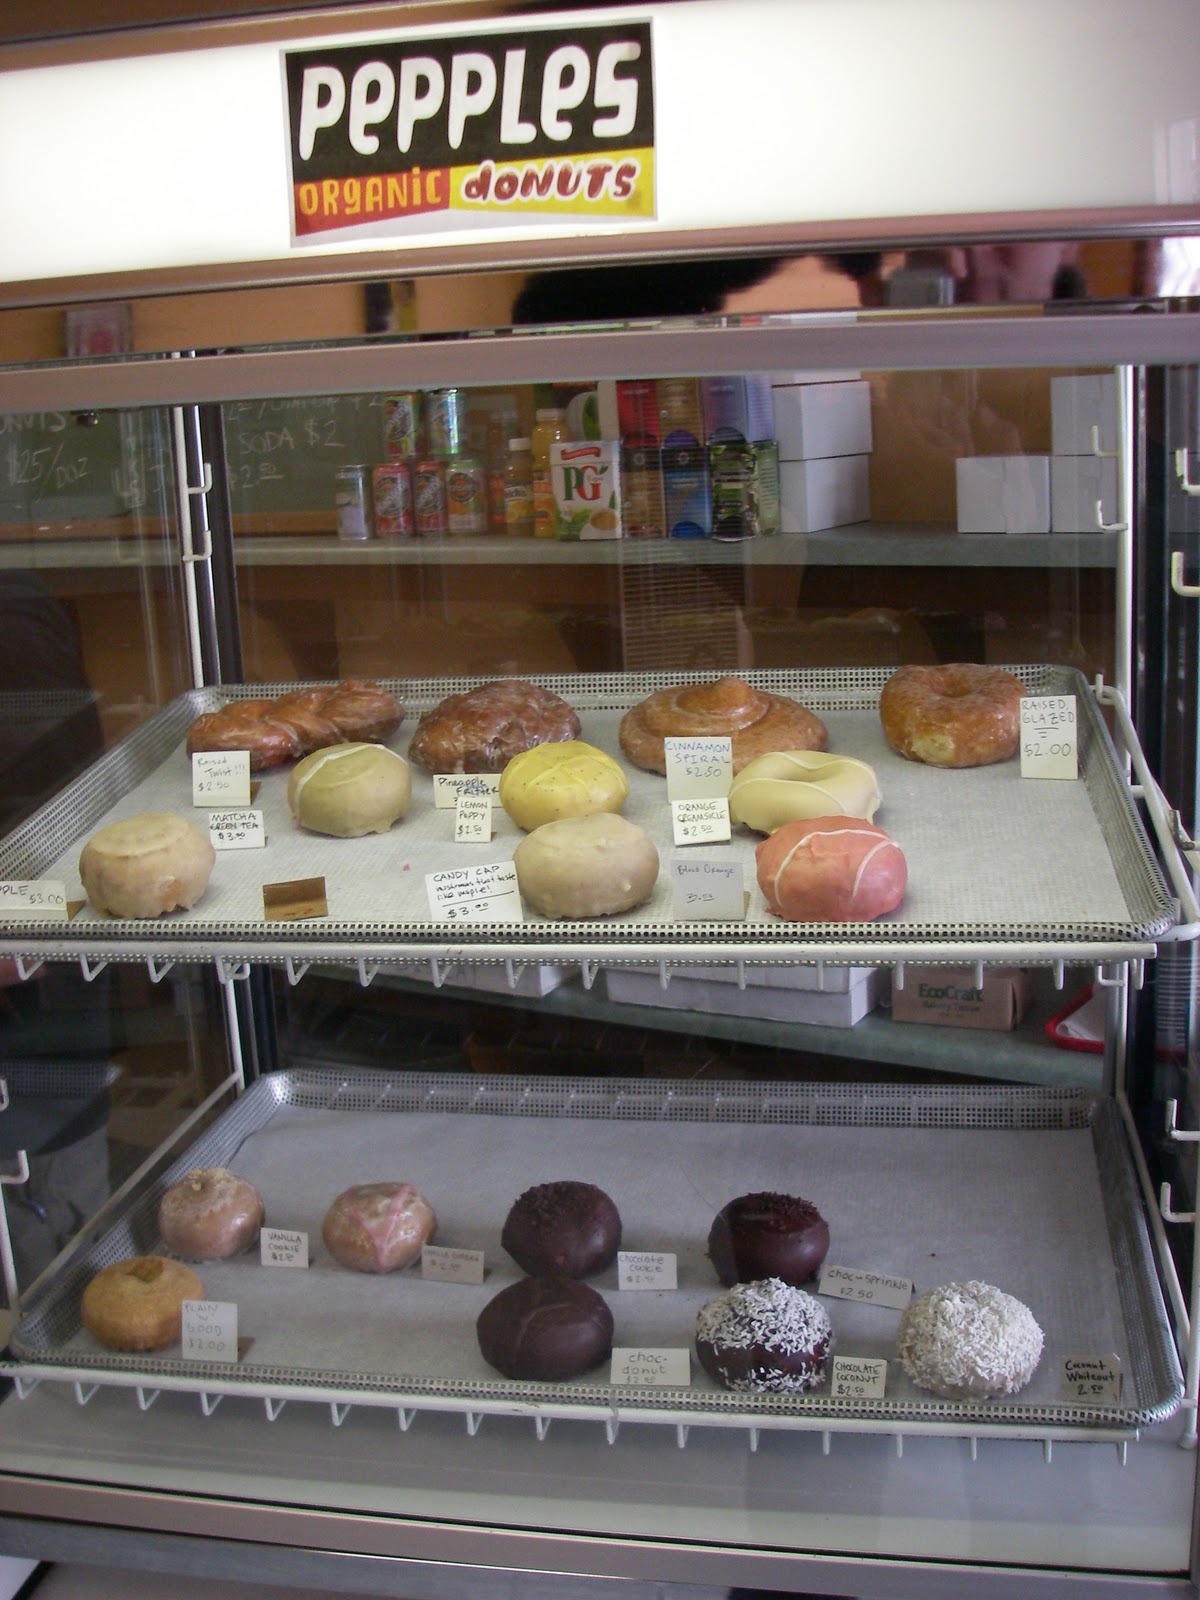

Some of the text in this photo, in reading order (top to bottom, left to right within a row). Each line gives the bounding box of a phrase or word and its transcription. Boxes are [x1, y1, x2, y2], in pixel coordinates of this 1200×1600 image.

[238, 427, 295, 455] SODA
[304, 419, 347, 447] $2
[1022, 711, 1075, 725] GLAZED
[665, 741, 731, 753] CINNAMON
[1023, 742, 1072, 757] $2.00
[674, 754, 731, 764] SPIRAL
[685, 767, 723, 778] $2.50
[460, 801, 488, 809] LEMON
[678, 803, 717, 812] ORANGE
[211, 812, 257, 822] MATCHA
[240, 821, 260, 830] TEA
[433, 865, 500, 883] CANDY CAP
[0, 884, 29, 896] PLE
[29, 893, 64, 905] $3.00
[267, 1232, 302, 1243] VANILLA
[268, 1243, 300, 1253] COOKIE
[835, 1361, 883, 1375] CHOCOLATE
[1065, 1359, 1107, 1371] Coconut
[836, 1373, 881, 1385] COCONUT
[1066, 1371, 1115, 1382] Whiteout
